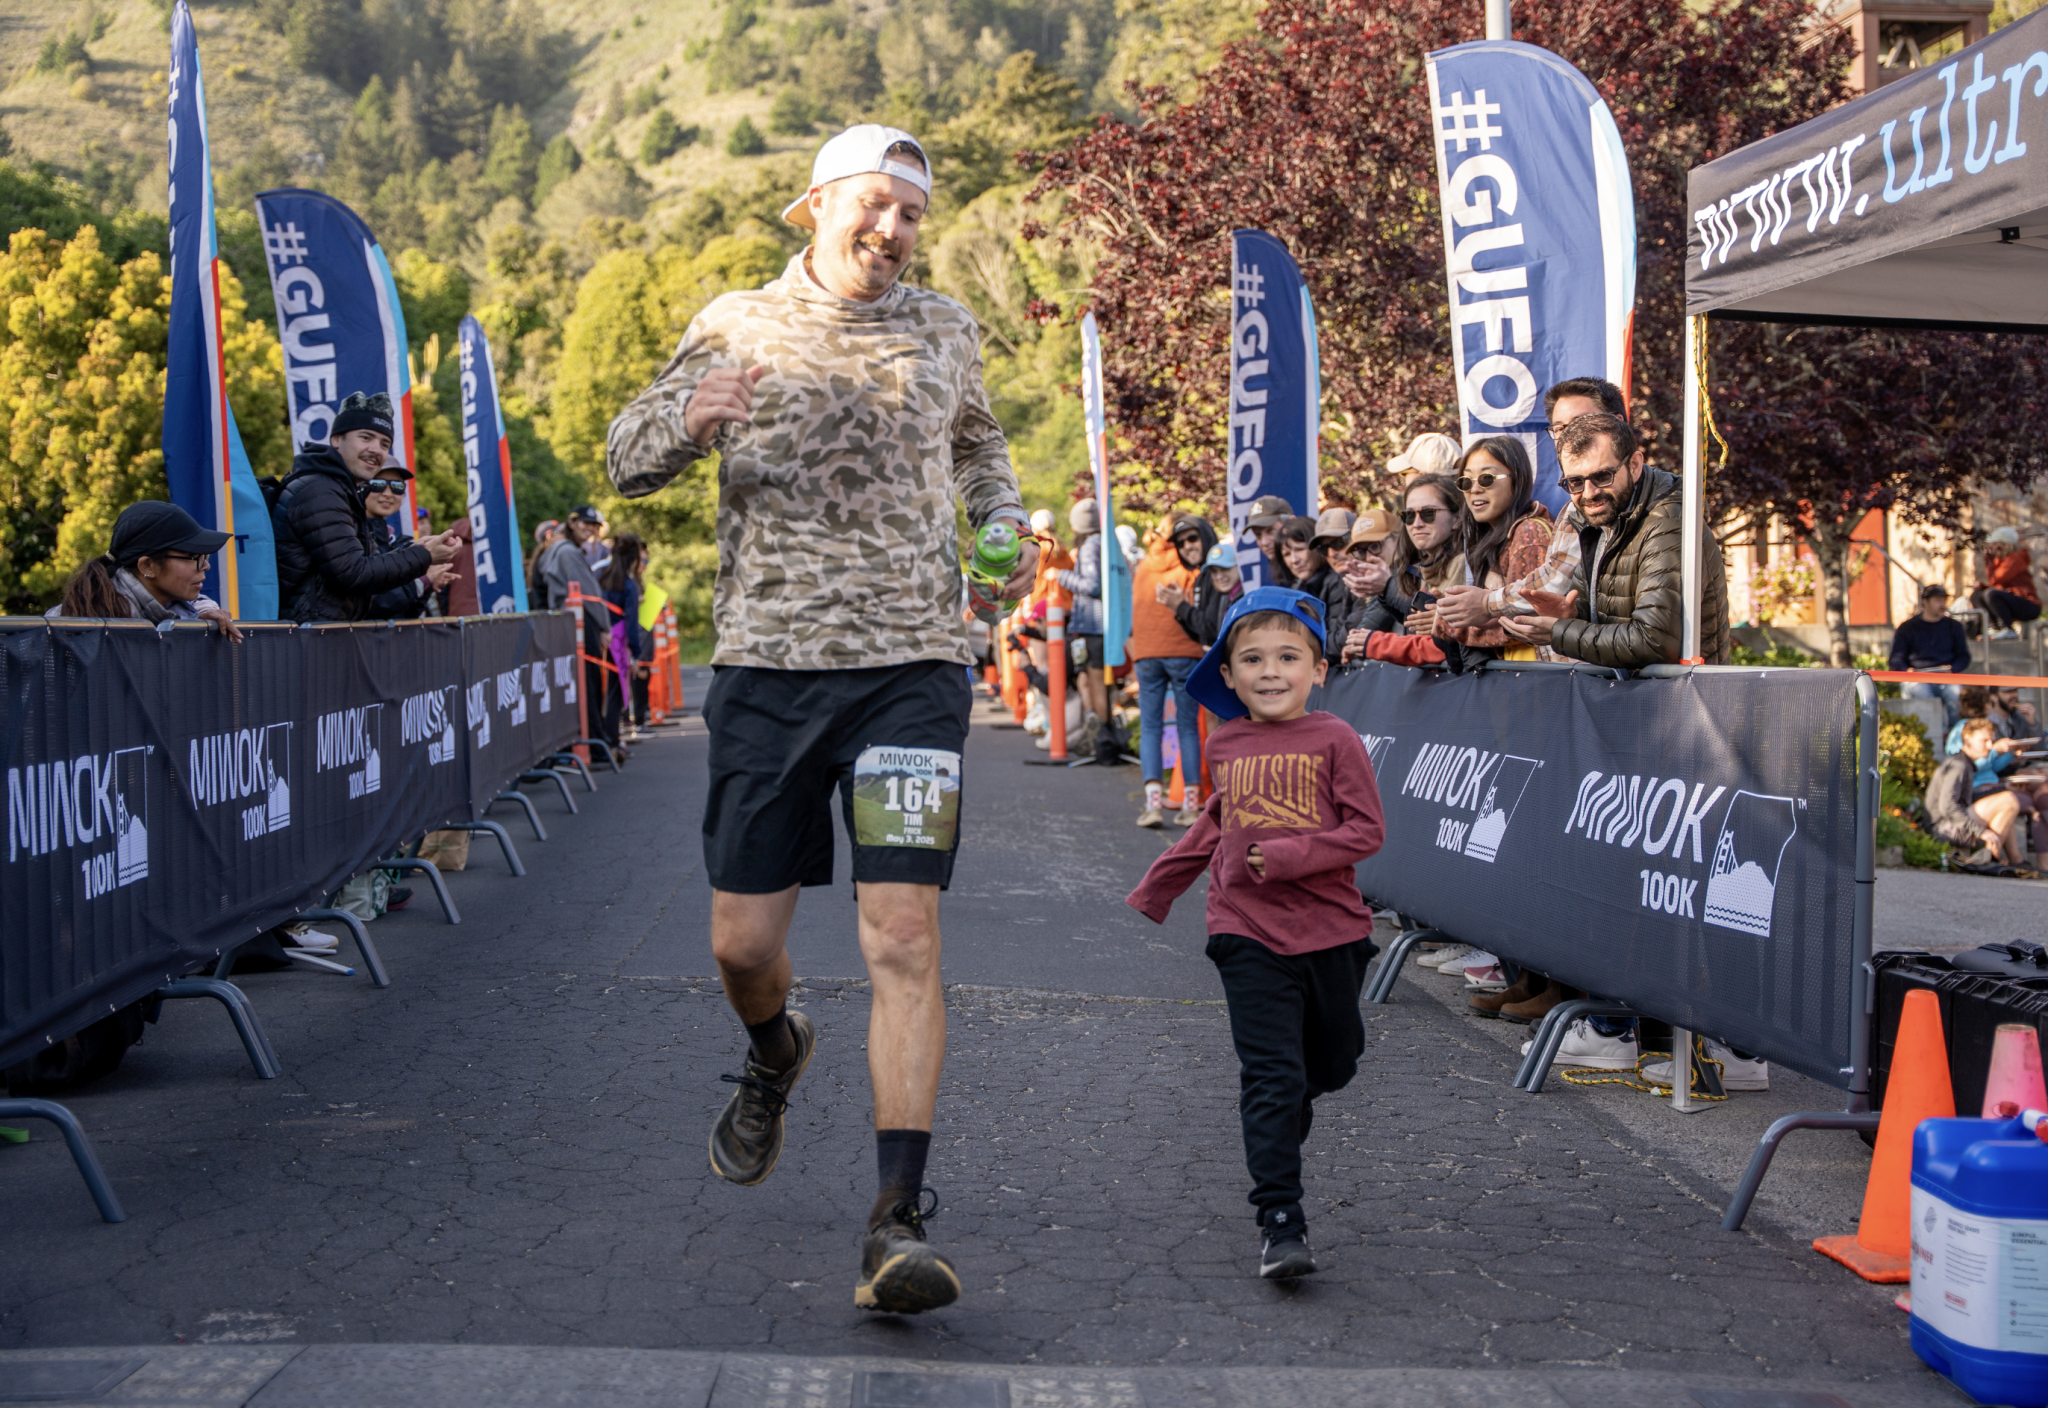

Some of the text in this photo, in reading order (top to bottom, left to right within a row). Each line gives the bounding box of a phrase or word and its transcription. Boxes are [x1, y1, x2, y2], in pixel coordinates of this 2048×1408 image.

[316, 706, 366, 774] MIWOK
[879, 753, 933, 767] MIWOK
[189, 726, 266, 810] MIWOK
[349, 770, 366, 800] 100K
[1231, 753, 1324, 824] OUTSIDE
[1401, 742, 1500, 811] MIWOK
[8, 752, 114, 863] MIWOK
[884, 776, 942, 814] 164
[903, 813, 923, 826] TIM
[1564, 770, 1727, 863] MIWOK
[242, 803, 267, 841] 100K
[886, 834, 904, 845] May
[915, 837, 936, 845] 2025
[1435, 817, 1470, 853] 100K
[81, 851, 117, 901] 100K
[1640, 869, 1699, 919] 100K
